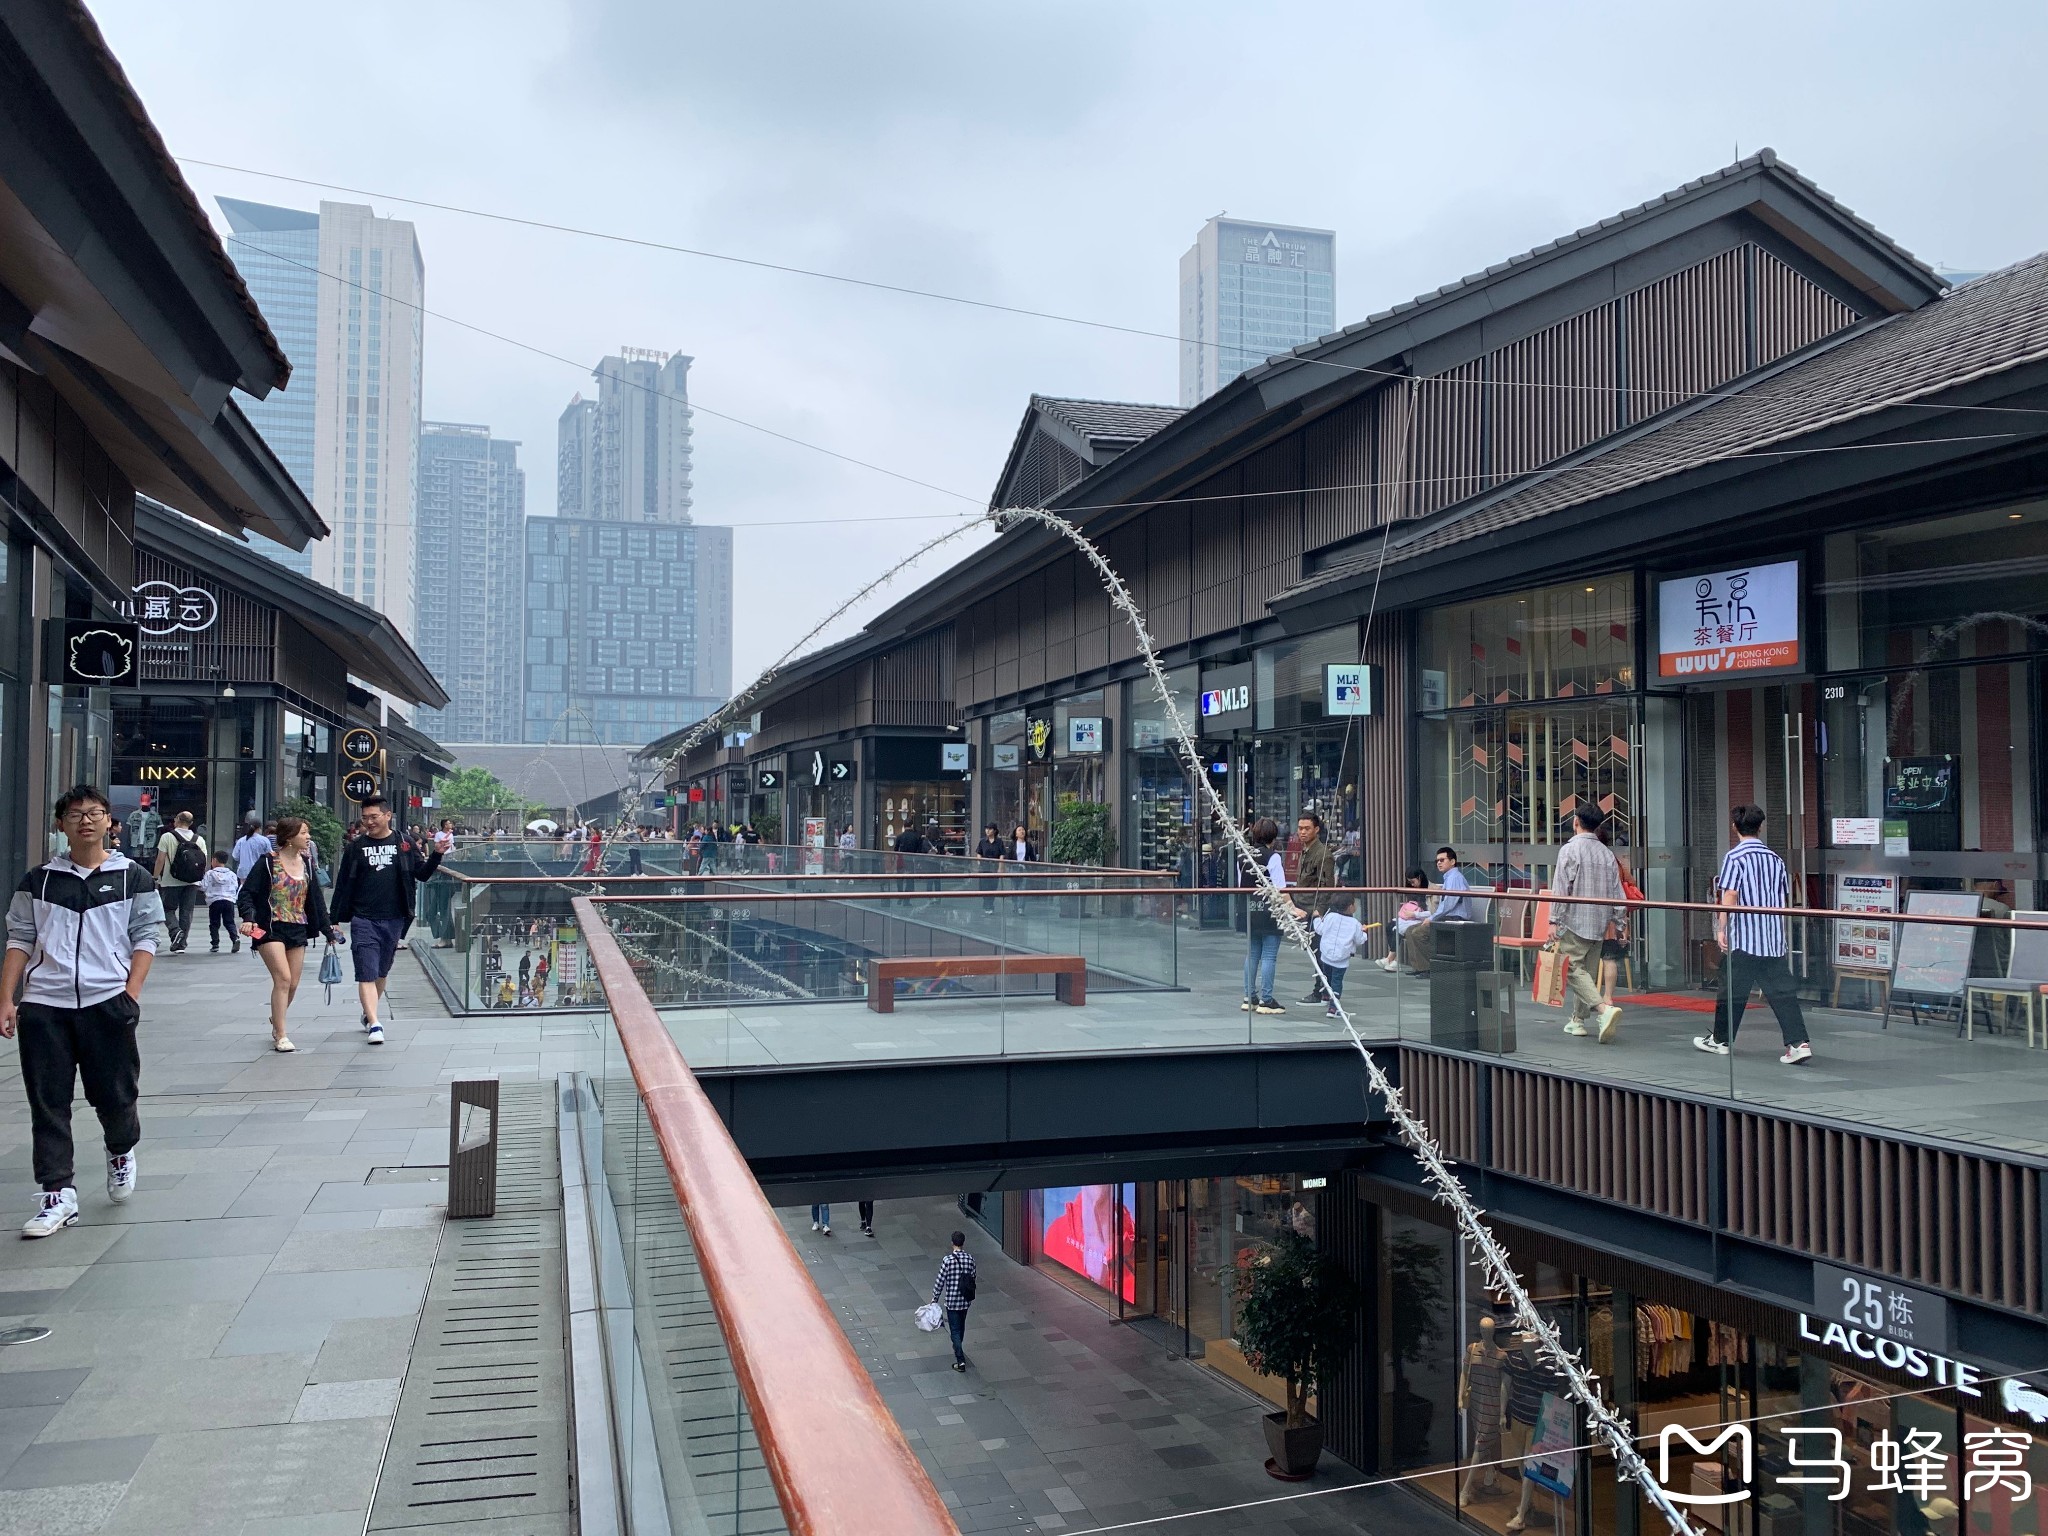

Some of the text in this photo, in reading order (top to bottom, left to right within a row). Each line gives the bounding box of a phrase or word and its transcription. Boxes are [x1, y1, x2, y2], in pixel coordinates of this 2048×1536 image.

[1242, 237, 1259, 246] THE
[1245, 245, 1305, 267] 晶融汇
[1694, 621, 1758, 646] 茶餐厅
[1736, 649, 1762, 660] HONG
[1763, 646, 1790, 658] KONG
[1736, 657, 1772, 669] CUISINE
[1336, 674, 1360, 685] MLB
[1221, 685, 1249, 712] MLB
[1825, 686, 1844, 699] 2310
[1076, 723, 1094, 731] MLB
[140, 766, 196, 780] INXX
[1903, 767, 1923, 777] OPEN
[362, 844, 398, 857] TALKING
[368, 854, 393, 866] GAME
[1302, 1177, 1327, 1189] WOMEN
[1888, 1327, 1914, 1341] BLOCK
[1799, 1312, 1982, 1398] LACOSTE
